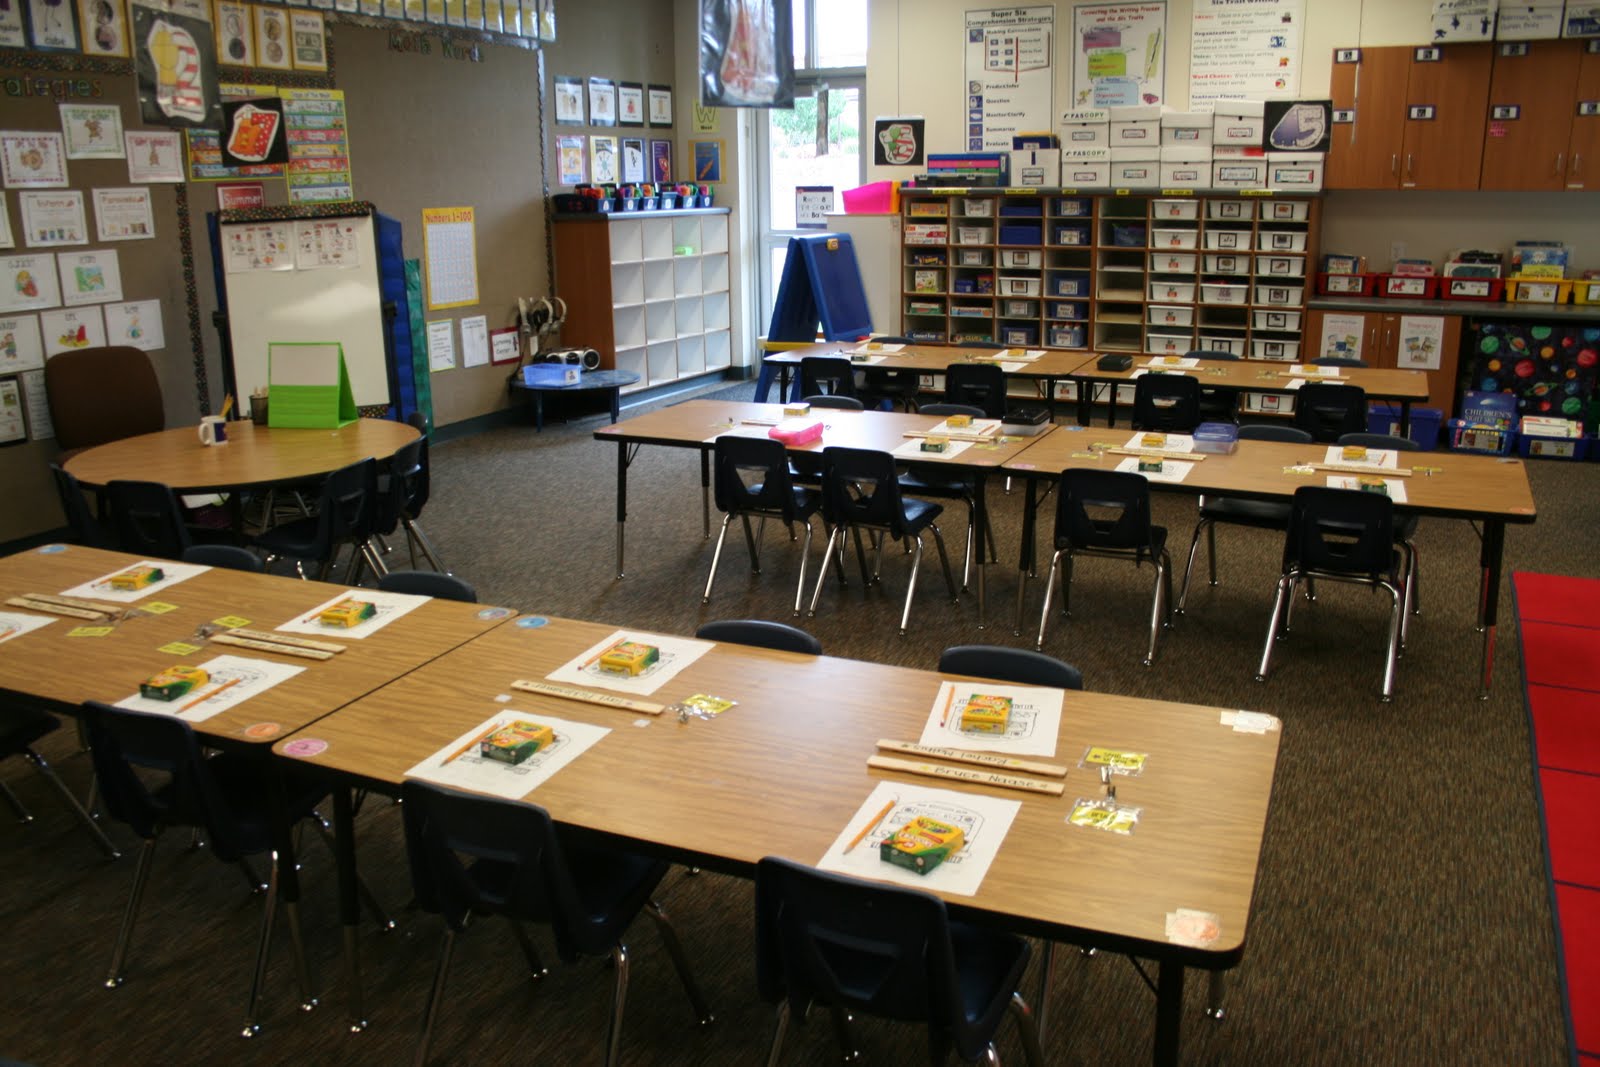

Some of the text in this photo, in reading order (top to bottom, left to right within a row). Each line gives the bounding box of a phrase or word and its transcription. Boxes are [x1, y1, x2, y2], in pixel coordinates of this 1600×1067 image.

[967, 16, 1051, 26] Comprehension Strategies
[224, 194, 262, 206] Summer
[425, 211, 472, 223] Numbers 1-100
[1464, 408, 1512, 419] CHILDREN'S
[934, 766, 981, 780] Bruce
